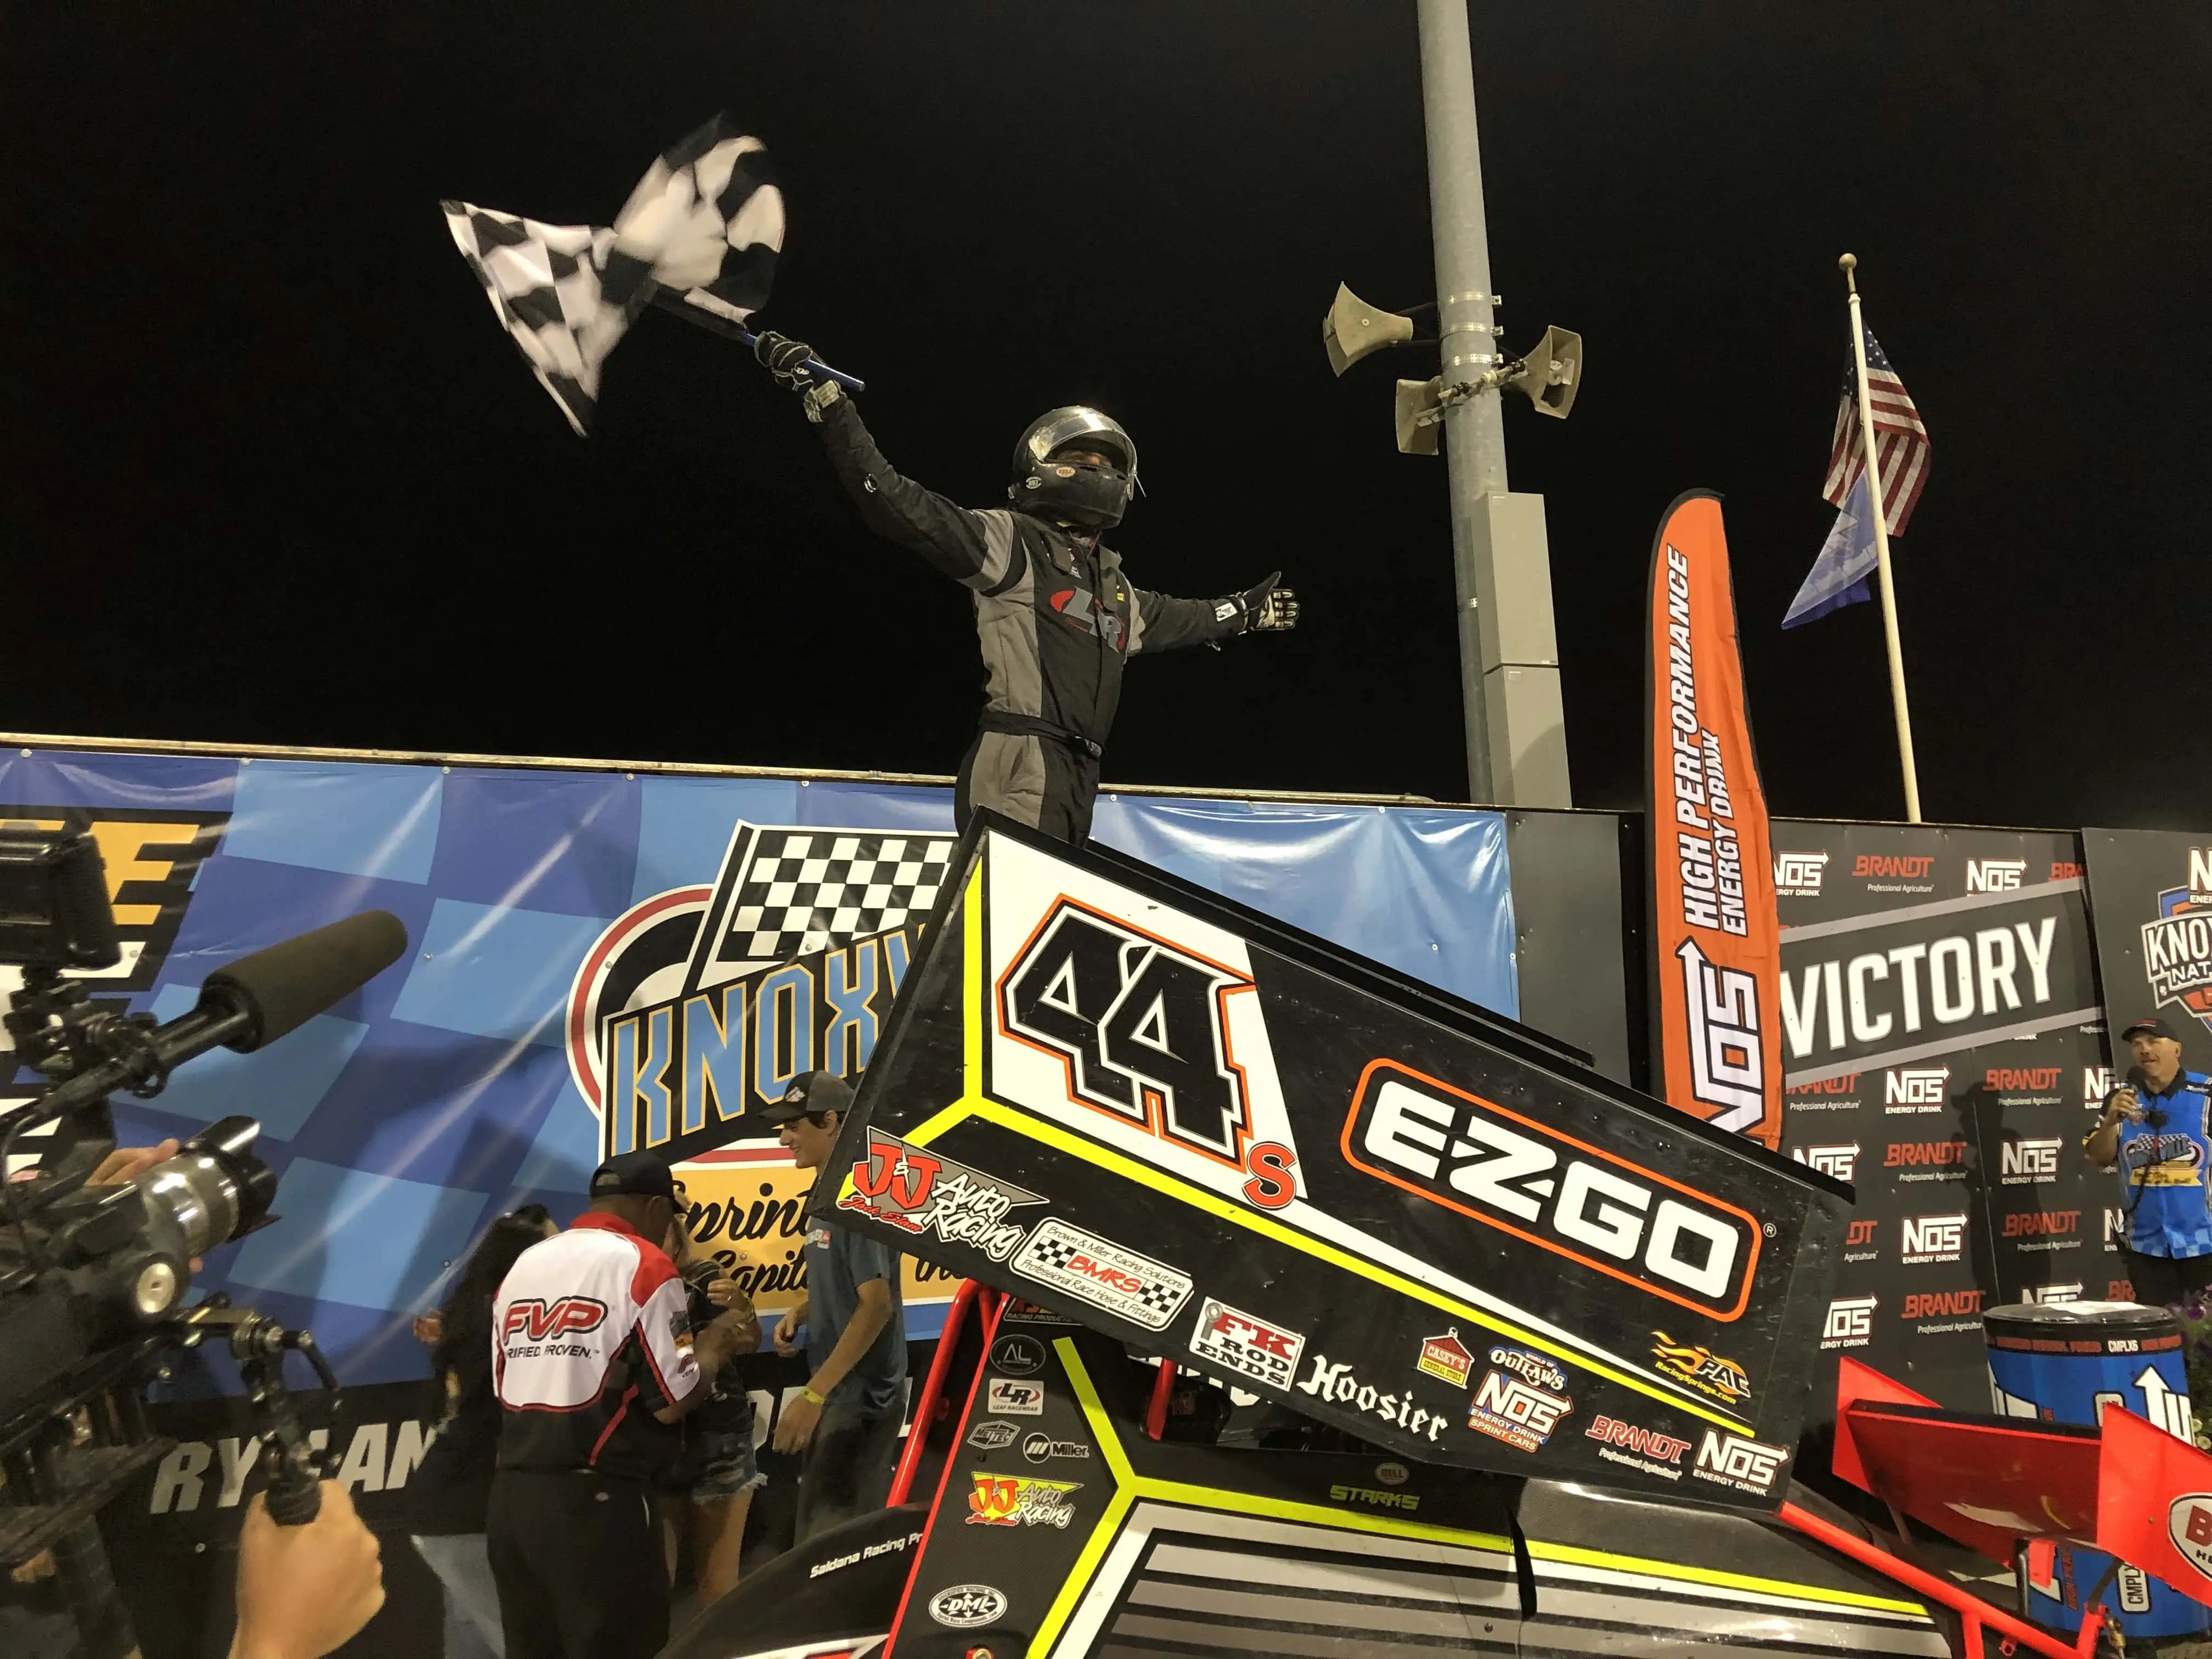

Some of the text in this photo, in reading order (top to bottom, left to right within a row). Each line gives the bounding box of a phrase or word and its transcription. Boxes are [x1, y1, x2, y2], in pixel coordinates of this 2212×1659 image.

[1667, 544, 1719, 931] HIGH PERFORMANCE
[1702, 728, 1748, 936] ENERGY DRINK
[1774, 852, 1830, 887] NOS
[1852, 855, 1935, 878] BRANDT
[1967, 860, 2027, 892] NOS
[1867, 884, 1934, 893] Professional Agriculture
[2147, 918, 2212, 972] KNO
[1780, 916, 2057, 1059] VICTORY
[1001, 900, 1251, 1160] 44
[1676, 937, 1765, 1138] NOS
[1886, 1066, 1950, 1104] NOS
[1983, 1068, 2062, 1091] BRANDT
[1790, 1101, 1859, 1111] Professional Agriculture
[1793, 1143, 1861, 1182] NOS
[1883, 1142, 1967, 1167] BRANDT
[2002, 1137, 2063, 1175] NOS
[853, 1142, 943, 1210] J&J
[1243, 1141, 1296, 1209] S
[1899, 1171, 1966, 1182] Professional Agriculture
[673, 1181, 811, 1243] print
[838, 1196, 881, 1216] Jack
[931, 1172, 1012, 1219] Auto
[922, 1198, 1024, 1256] Racing
[1903, 1214, 1968, 1254] NOS
[2001, 1210, 2081, 1237] BRANDT
[1046, 1226, 1186, 1289] Brown & Miller Racing Solutions
[1066, 1255, 1142, 1293] BMRS
[1844, 1252, 1878, 1263] Agriculture
[1903, 1253, 1960, 1264] ENERGY DRINK
[1020, 1259, 1162, 1323] Professional Race Hose & Fittings
[1901, 1290, 1987, 1319] BRANDT
[502, 1295, 608, 1346] FVP
[1033, 1314, 1071, 1322] PRODUC
[1212, 1312, 1296, 1361] FK
[1917, 1323, 1954, 1334] Professional
[1220, 1336, 1289, 1372] ROD
[1427, 1346, 1466, 1370] CASEY'S
[1843, 1338, 1869, 1347] DRINK
[1195, 1341, 1286, 1385] ENDS
[1694, 1357, 1751, 1398] PAC
[1000, 1383, 1032, 1405] LR
[1296, 1355, 1448, 1442] Hoosier
[1654, 1361, 1737, 1404] RacingSprings.com
[1474, 1371, 1574, 1435] NOS
[1470, 1408, 1545, 1444] ENERGY DRINK
[1470, 1418, 1537, 1451] SPRINT CARS
[1585, 1414, 1691, 1464] BRANDT
[150, 1420, 437, 1515] RYAN
[1380, 1468, 1403, 1478] BELL
[1599, 1447, 1683, 1481] Professional Agriculture
[1696, 1430, 1791, 1486] NOS
[1017, 1482, 1062, 1504] Auto
[1330, 1485, 1420, 1510] STARKS
[1693, 1469, 1768, 1497] ENERGY DRINK
[1016, 1501, 1074, 1527] Racing
[810, 1552, 860, 1578] Saldana
[863, 1537, 906, 1560] Racing
